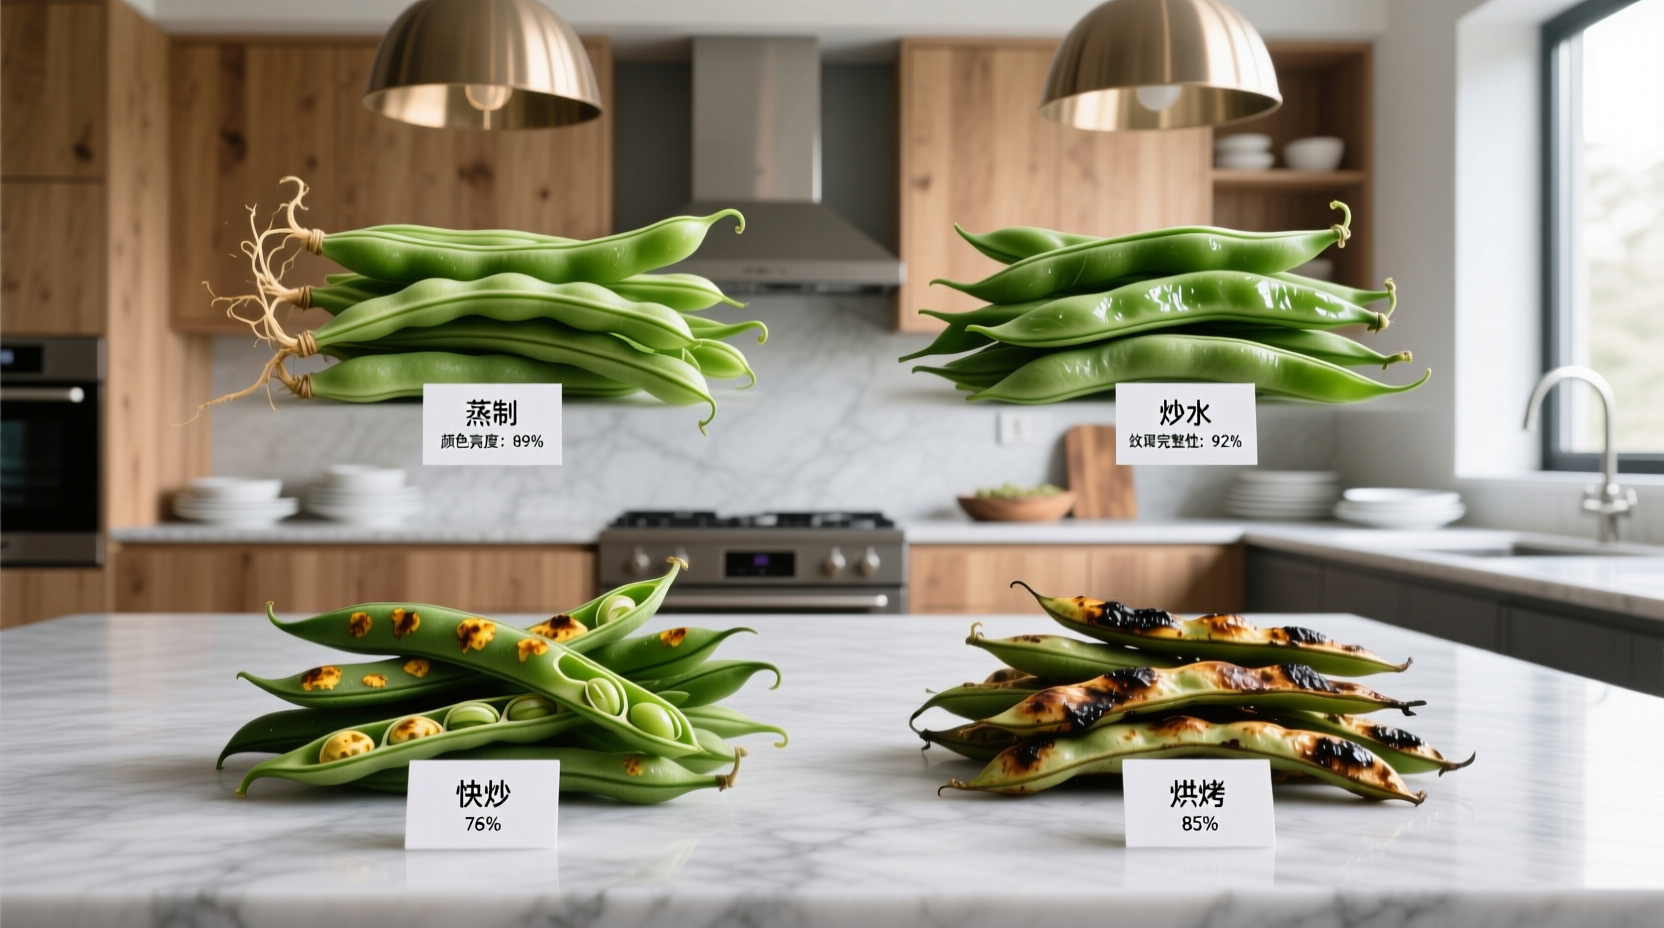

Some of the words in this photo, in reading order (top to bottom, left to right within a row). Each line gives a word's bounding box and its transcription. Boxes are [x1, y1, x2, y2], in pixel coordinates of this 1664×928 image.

[466, 399, 517, 427] 蒸制
[1160, 399, 1212, 426] 炒水
[456, 780, 511, 808] 快炒
[1171, 780, 1226, 808] 烘烤
[466, 816, 502, 832] 76%
[1182, 816, 1219, 832] 85%
